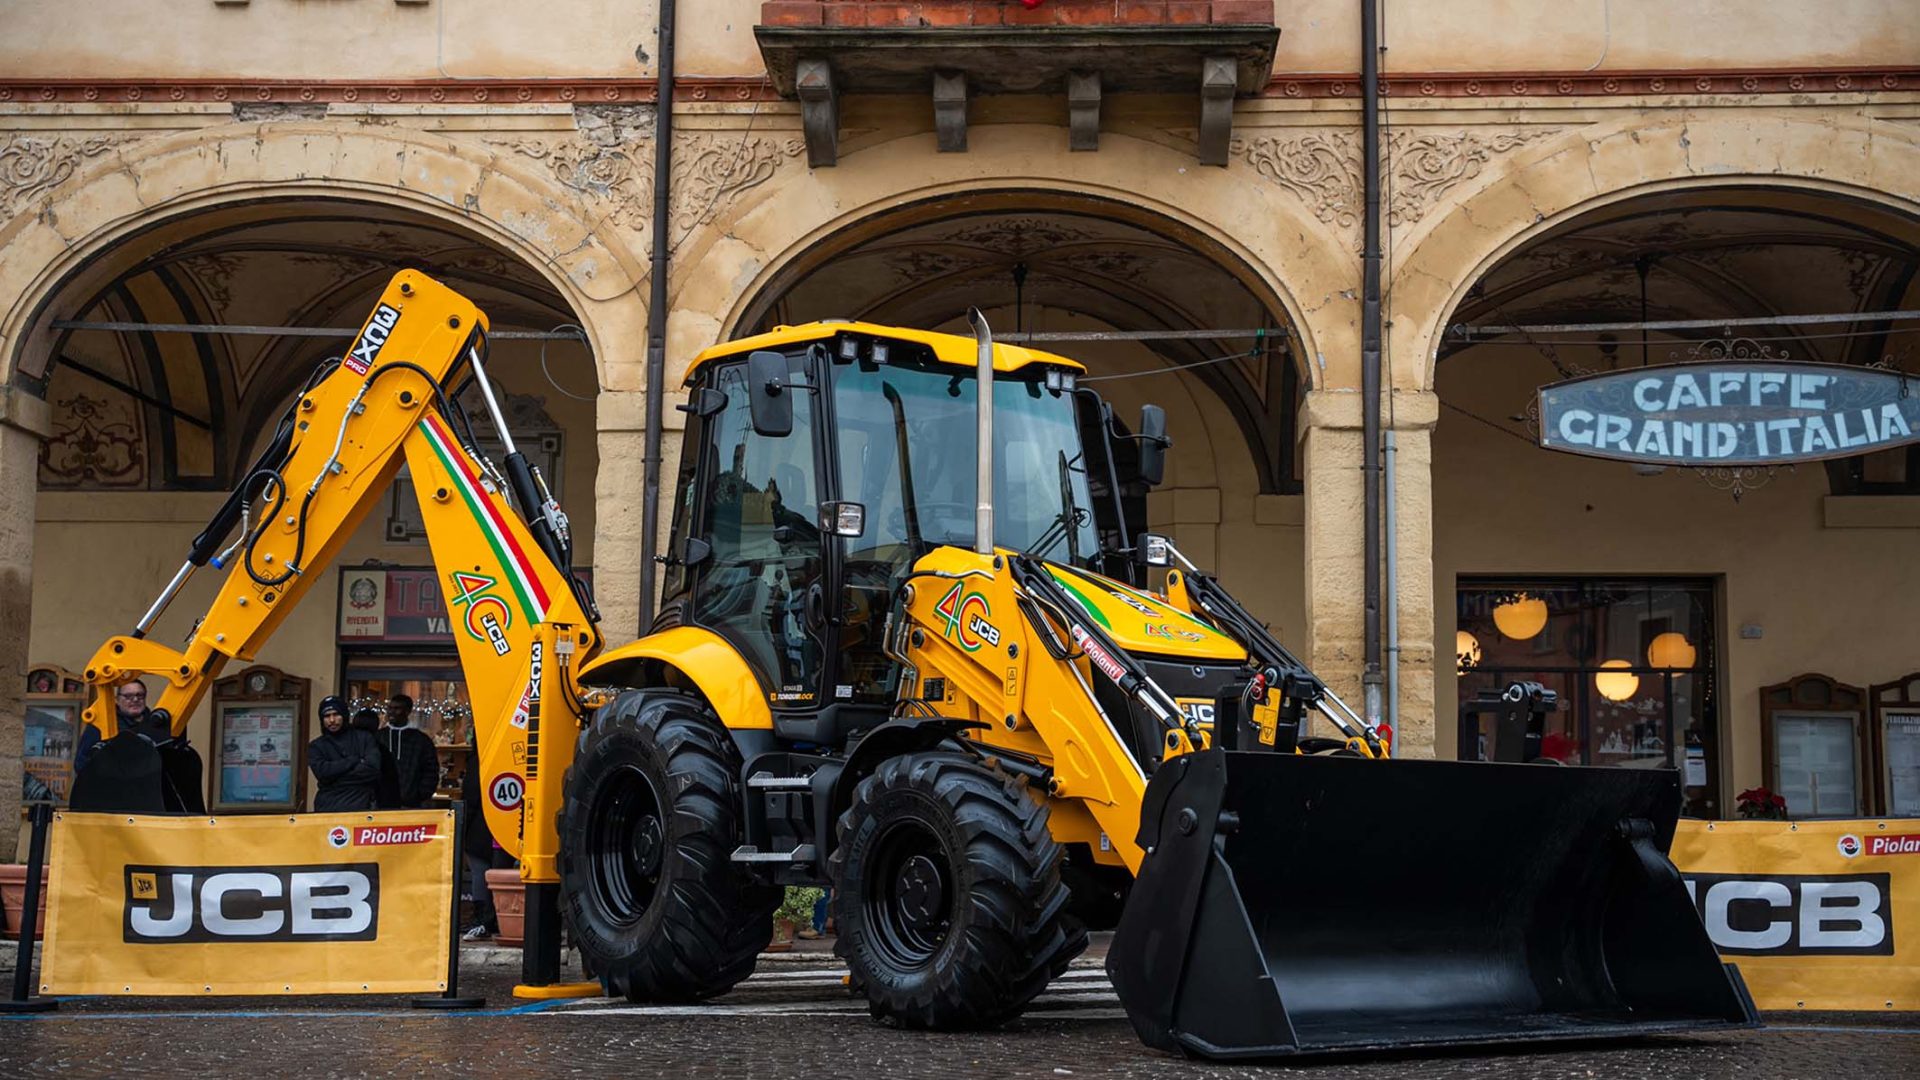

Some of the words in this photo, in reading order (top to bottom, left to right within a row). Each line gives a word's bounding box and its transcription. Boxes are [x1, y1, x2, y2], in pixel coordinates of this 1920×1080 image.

[352, 305, 399, 363] 3CX
[345, 359, 367, 375] PRO
[1559, 403, 1912, 458] GRAND'ITALIA
[393, 576, 443, 612] TA
[427, 618, 453, 633] VA
[481, 615, 510, 656] JCB
[969, 616, 1001, 647] JCB
[530, 643, 541, 698] 3CX
[1084, 640, 1120, 679] Piolanti
[1183, 704, 1215, 722] JC
[497, 781, 519, 801] 40
[359, 827, 427, 845] Piolanti
[1872, 837, 1920, 853] Piolan
[131, 871, 372, 937] JCB
